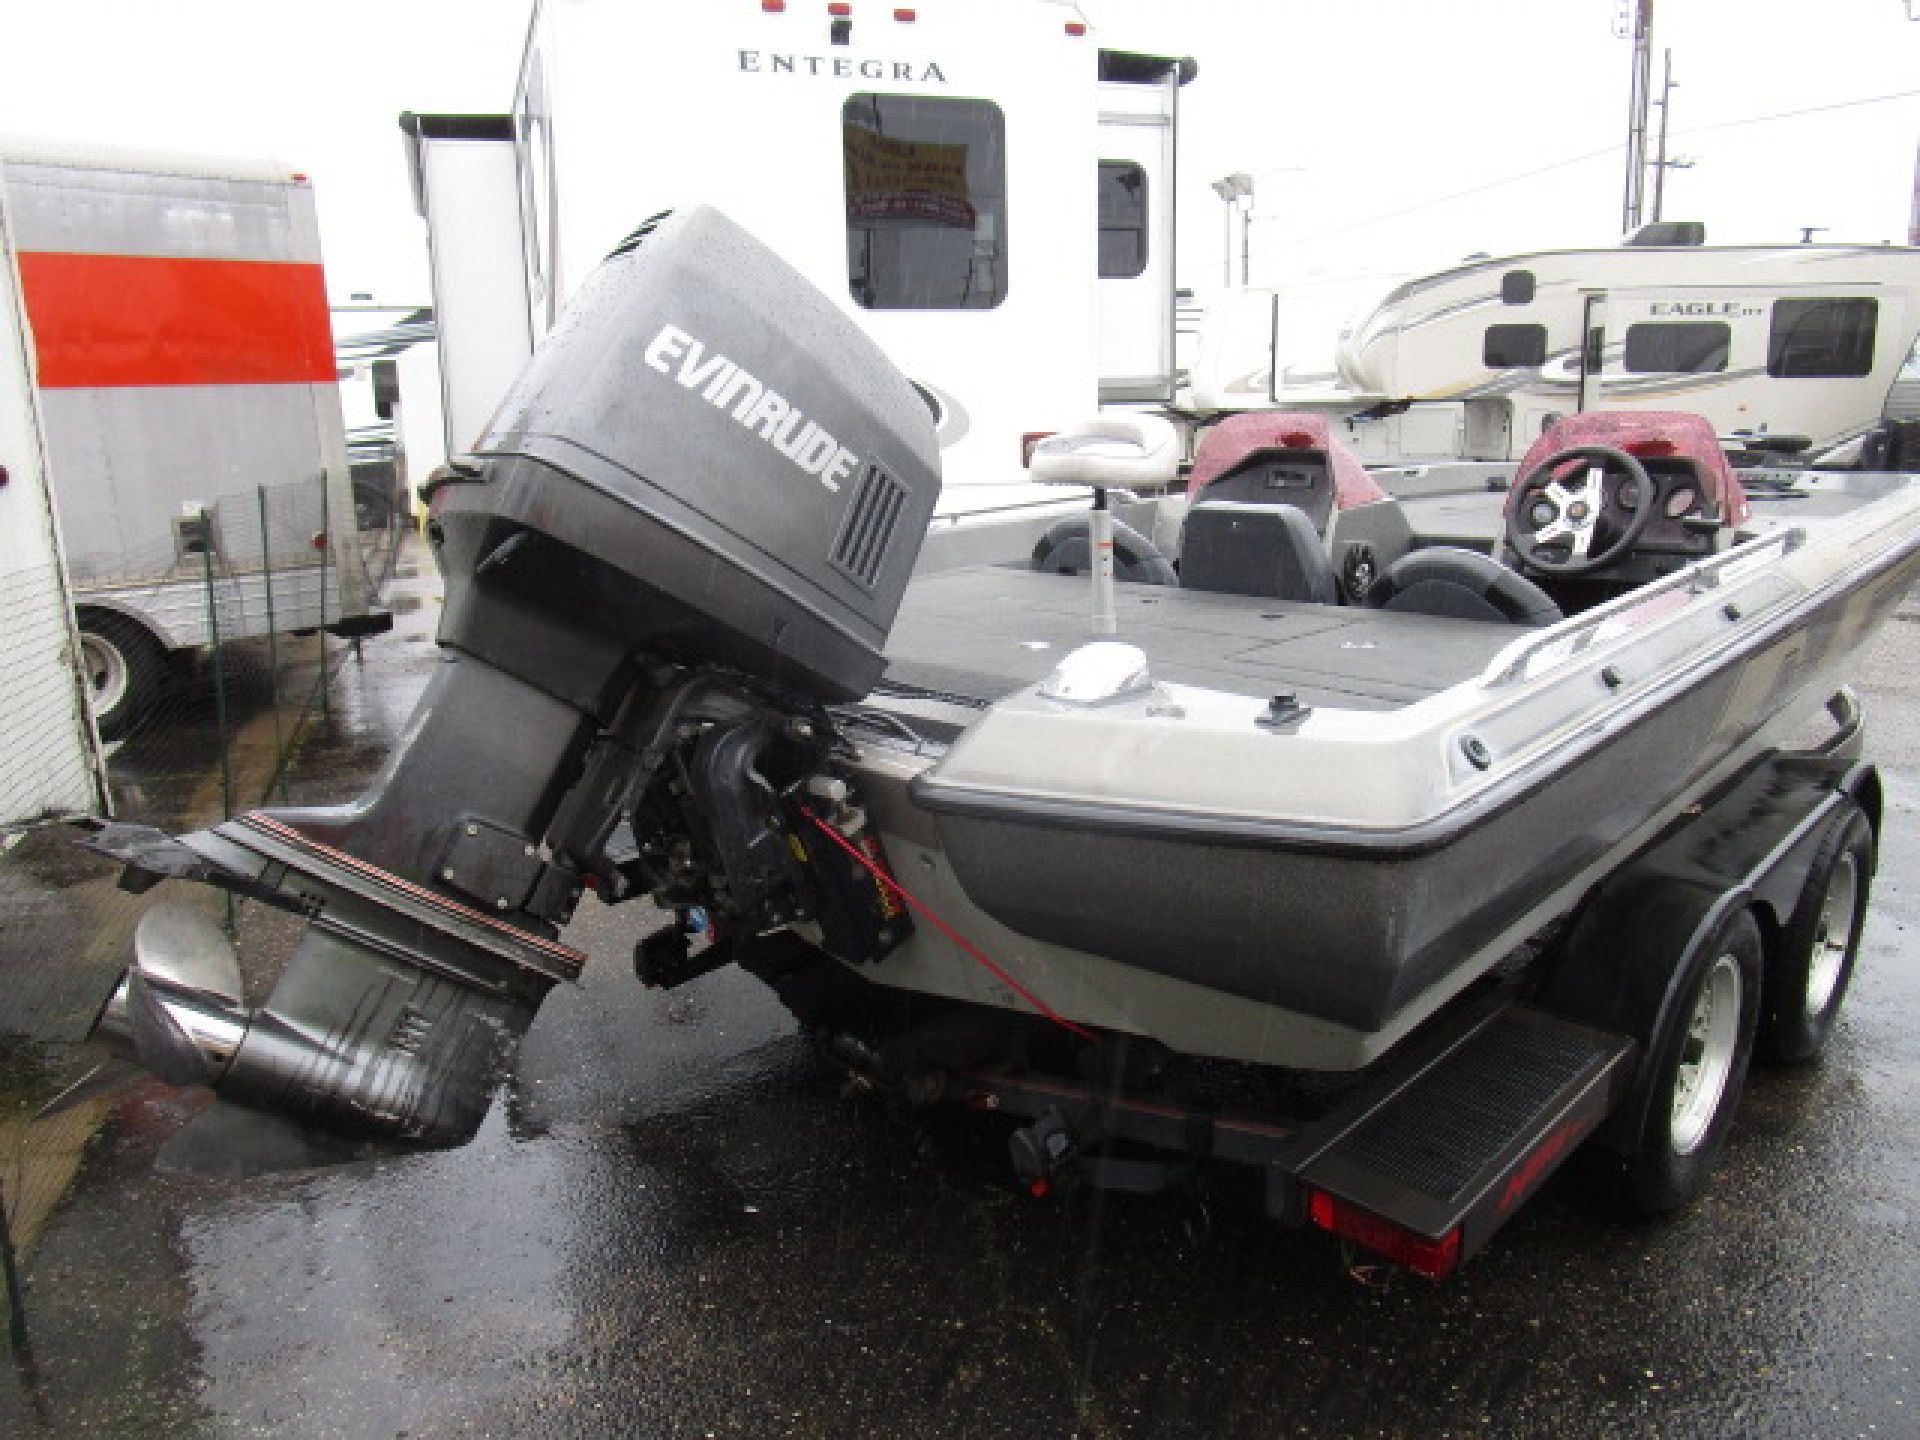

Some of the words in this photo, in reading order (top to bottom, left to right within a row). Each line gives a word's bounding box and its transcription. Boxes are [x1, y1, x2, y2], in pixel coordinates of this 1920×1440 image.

[737, 49, 948, 84] ENTEGRA
[1650, 302, 1740, 318] EAGLE
[644, 323, 859, 493] EVINRUDE
